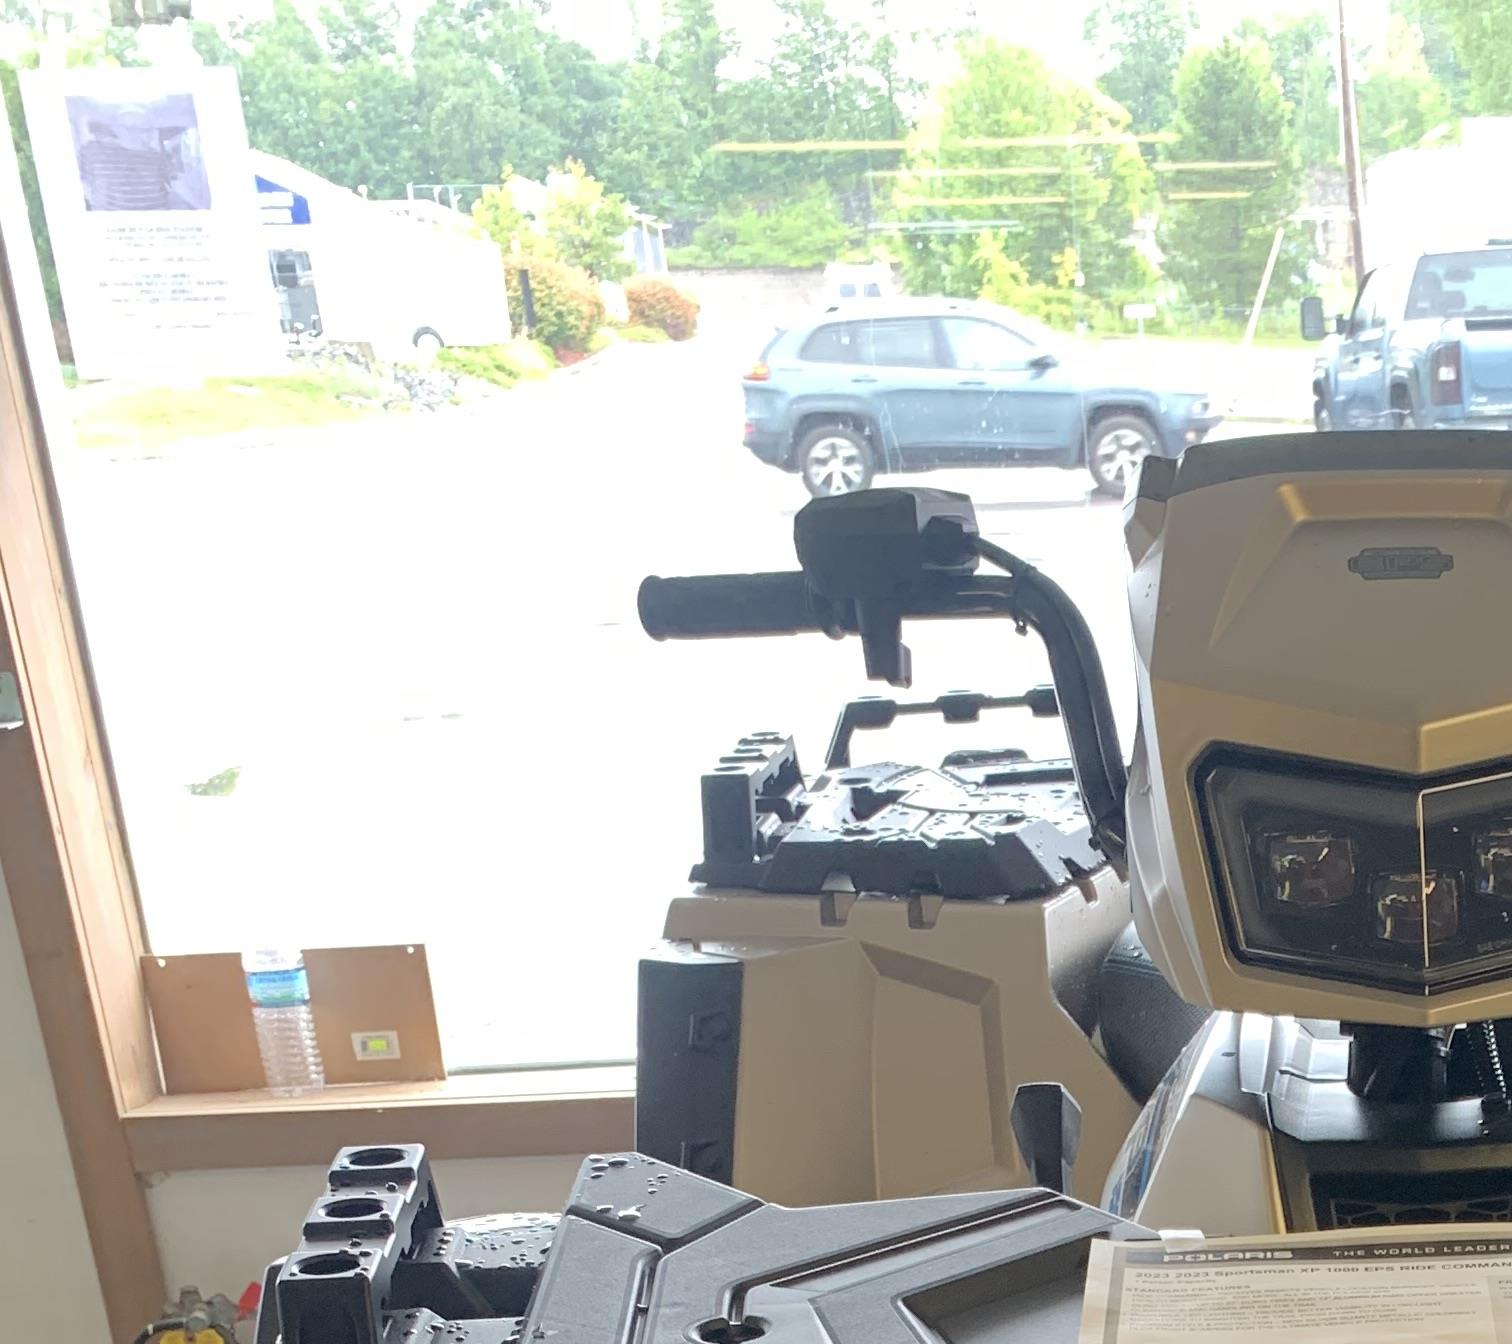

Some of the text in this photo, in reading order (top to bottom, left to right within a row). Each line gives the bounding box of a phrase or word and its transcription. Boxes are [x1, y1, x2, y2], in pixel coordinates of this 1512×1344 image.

[1163, 1250, 1294, 1263] POLARIS
[1332, 1249, 1366, 1257] THE
[1373, 1246, 1436, 1256] WORLD
[1443, 1243, 1511, 1253] LEADER
[1135, 1271, 1170, 1279] 2023
[1175, 1270, 1210, 1279] 2023
[1214, 1267, 1296, 1279] Sportsman
[1300, 1266, 1321, 1274] XP
[1327, 1265, 1360, 1273] 1000
[1364, 1264, 1395, 1273] EPS
